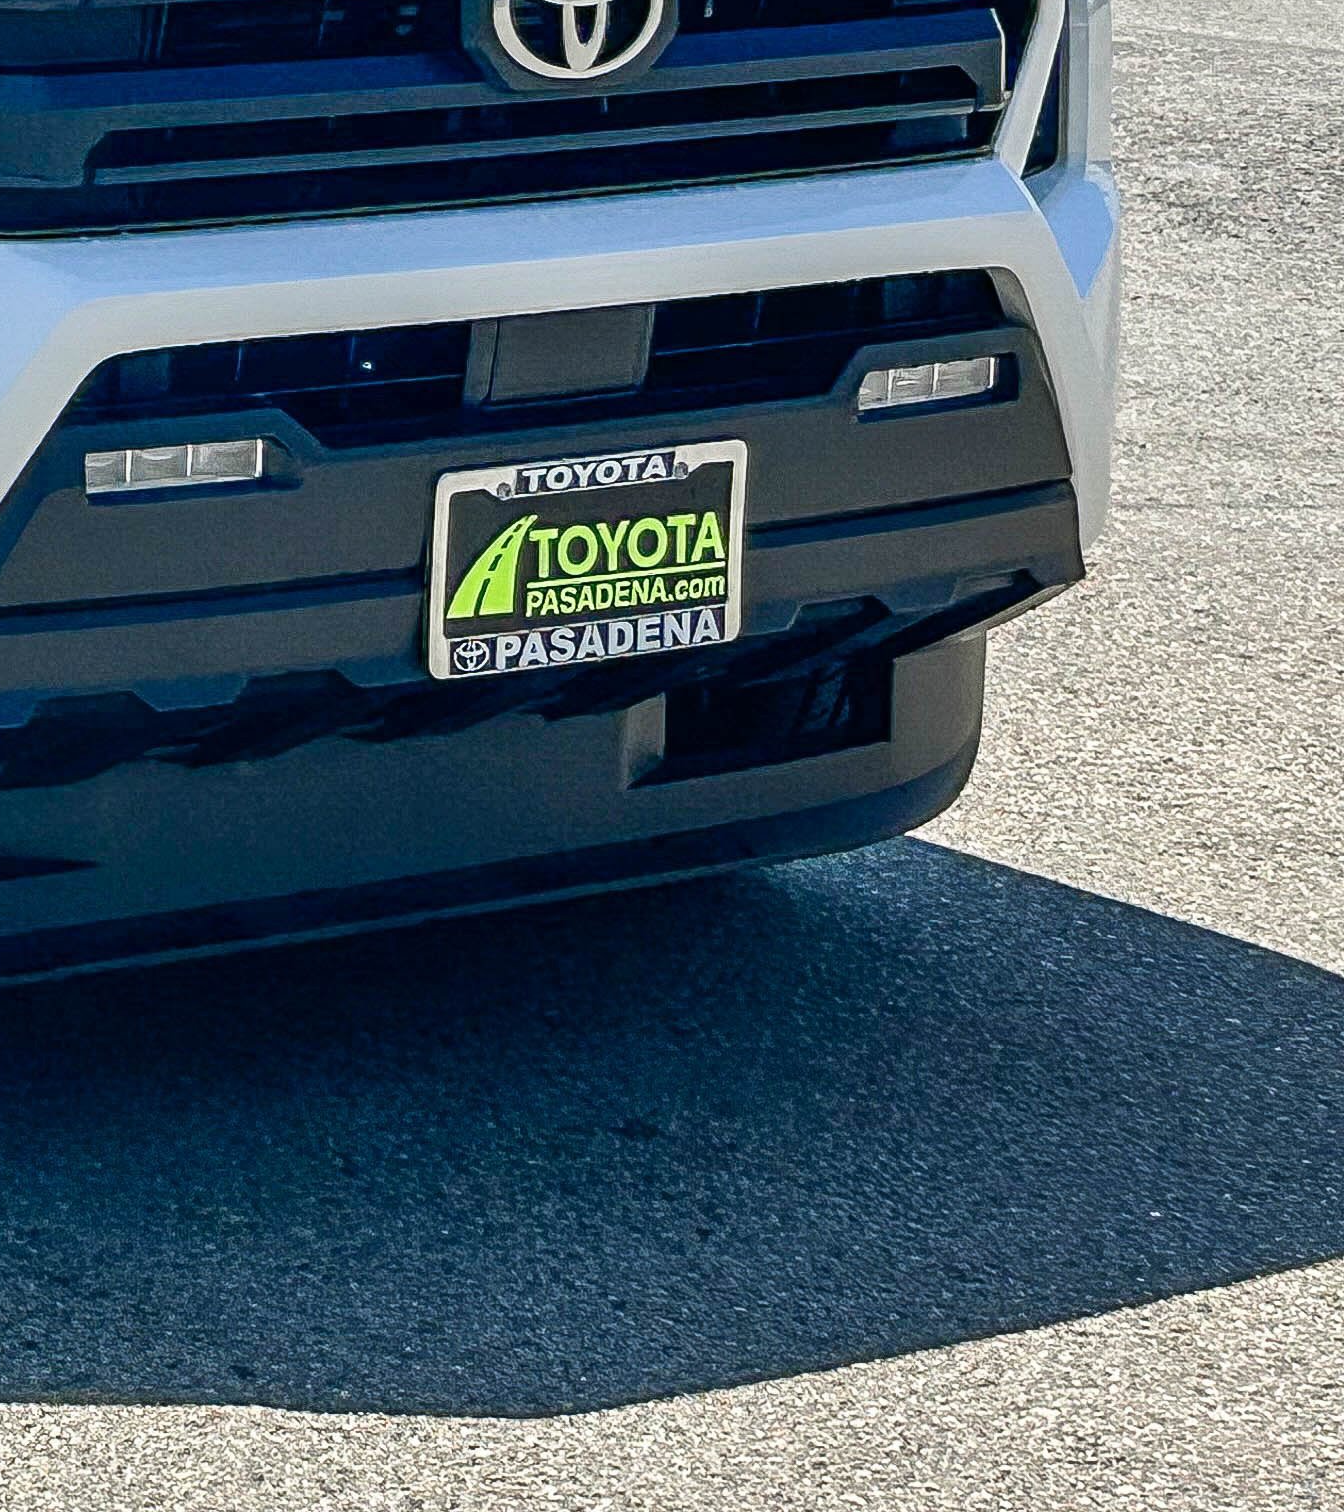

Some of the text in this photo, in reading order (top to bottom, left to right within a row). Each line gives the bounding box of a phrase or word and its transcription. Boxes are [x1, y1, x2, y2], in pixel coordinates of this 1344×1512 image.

[521, 454, 667, 493] TOYOTA
[528, 511, 725, 579] TOYOTA
[525, 575, 725, 618] PASADENA.com
[495, 608, 721, 670] PASADENA
